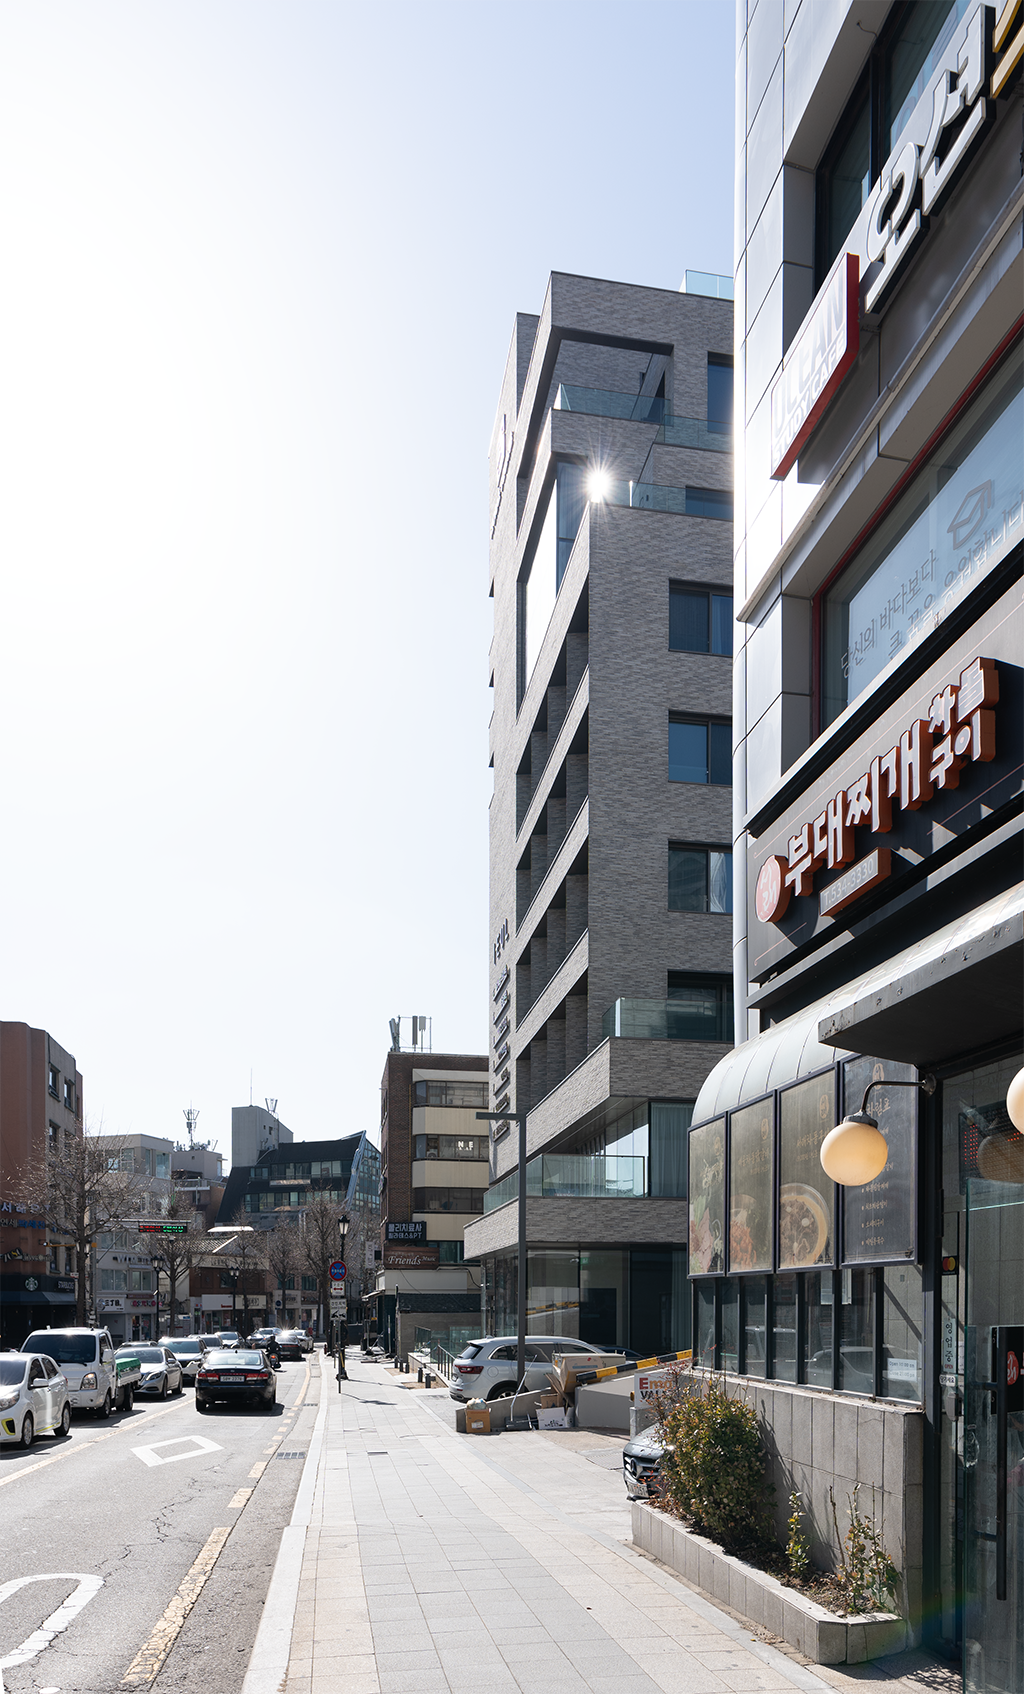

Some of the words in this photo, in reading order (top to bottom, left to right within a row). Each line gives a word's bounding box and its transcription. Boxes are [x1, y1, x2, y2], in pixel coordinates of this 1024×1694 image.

[811, 329, 846, 400] CAFE
[841, 618, 875, 678] 당신의
[879, 549, 938, 630] 바다보다
[927, 655, 986, 736] 차돌
[928, 707, 982, 790] 구이
[784, 718, 921, 896] 부대찌개
[823, 857, 875, 907] T.534-3330
[388, 1255, 422, 1266] Friends
[944, 1322, 954, 1363] 영업중
